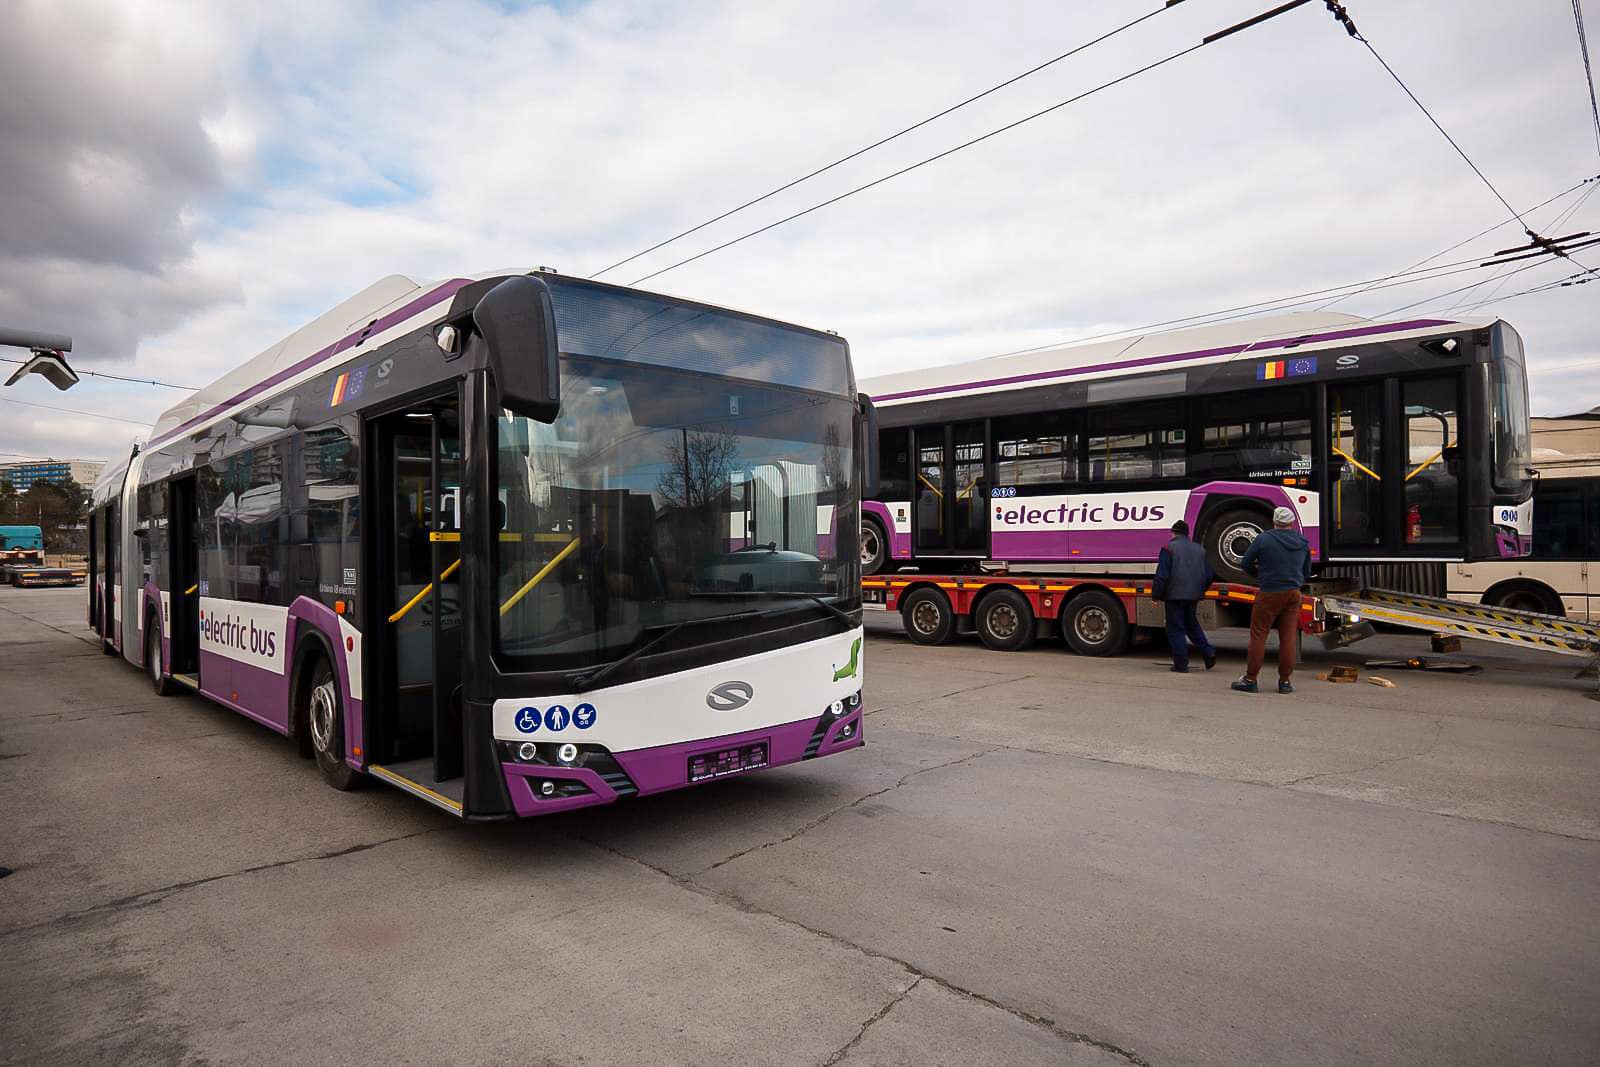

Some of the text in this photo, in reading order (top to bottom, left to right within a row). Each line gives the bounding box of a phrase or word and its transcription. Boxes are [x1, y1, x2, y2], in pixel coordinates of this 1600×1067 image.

[1004, 501, 1165, 525] electric bus
[204, 611, 247, 650] electric
[250, 618, 276, 657] bus
